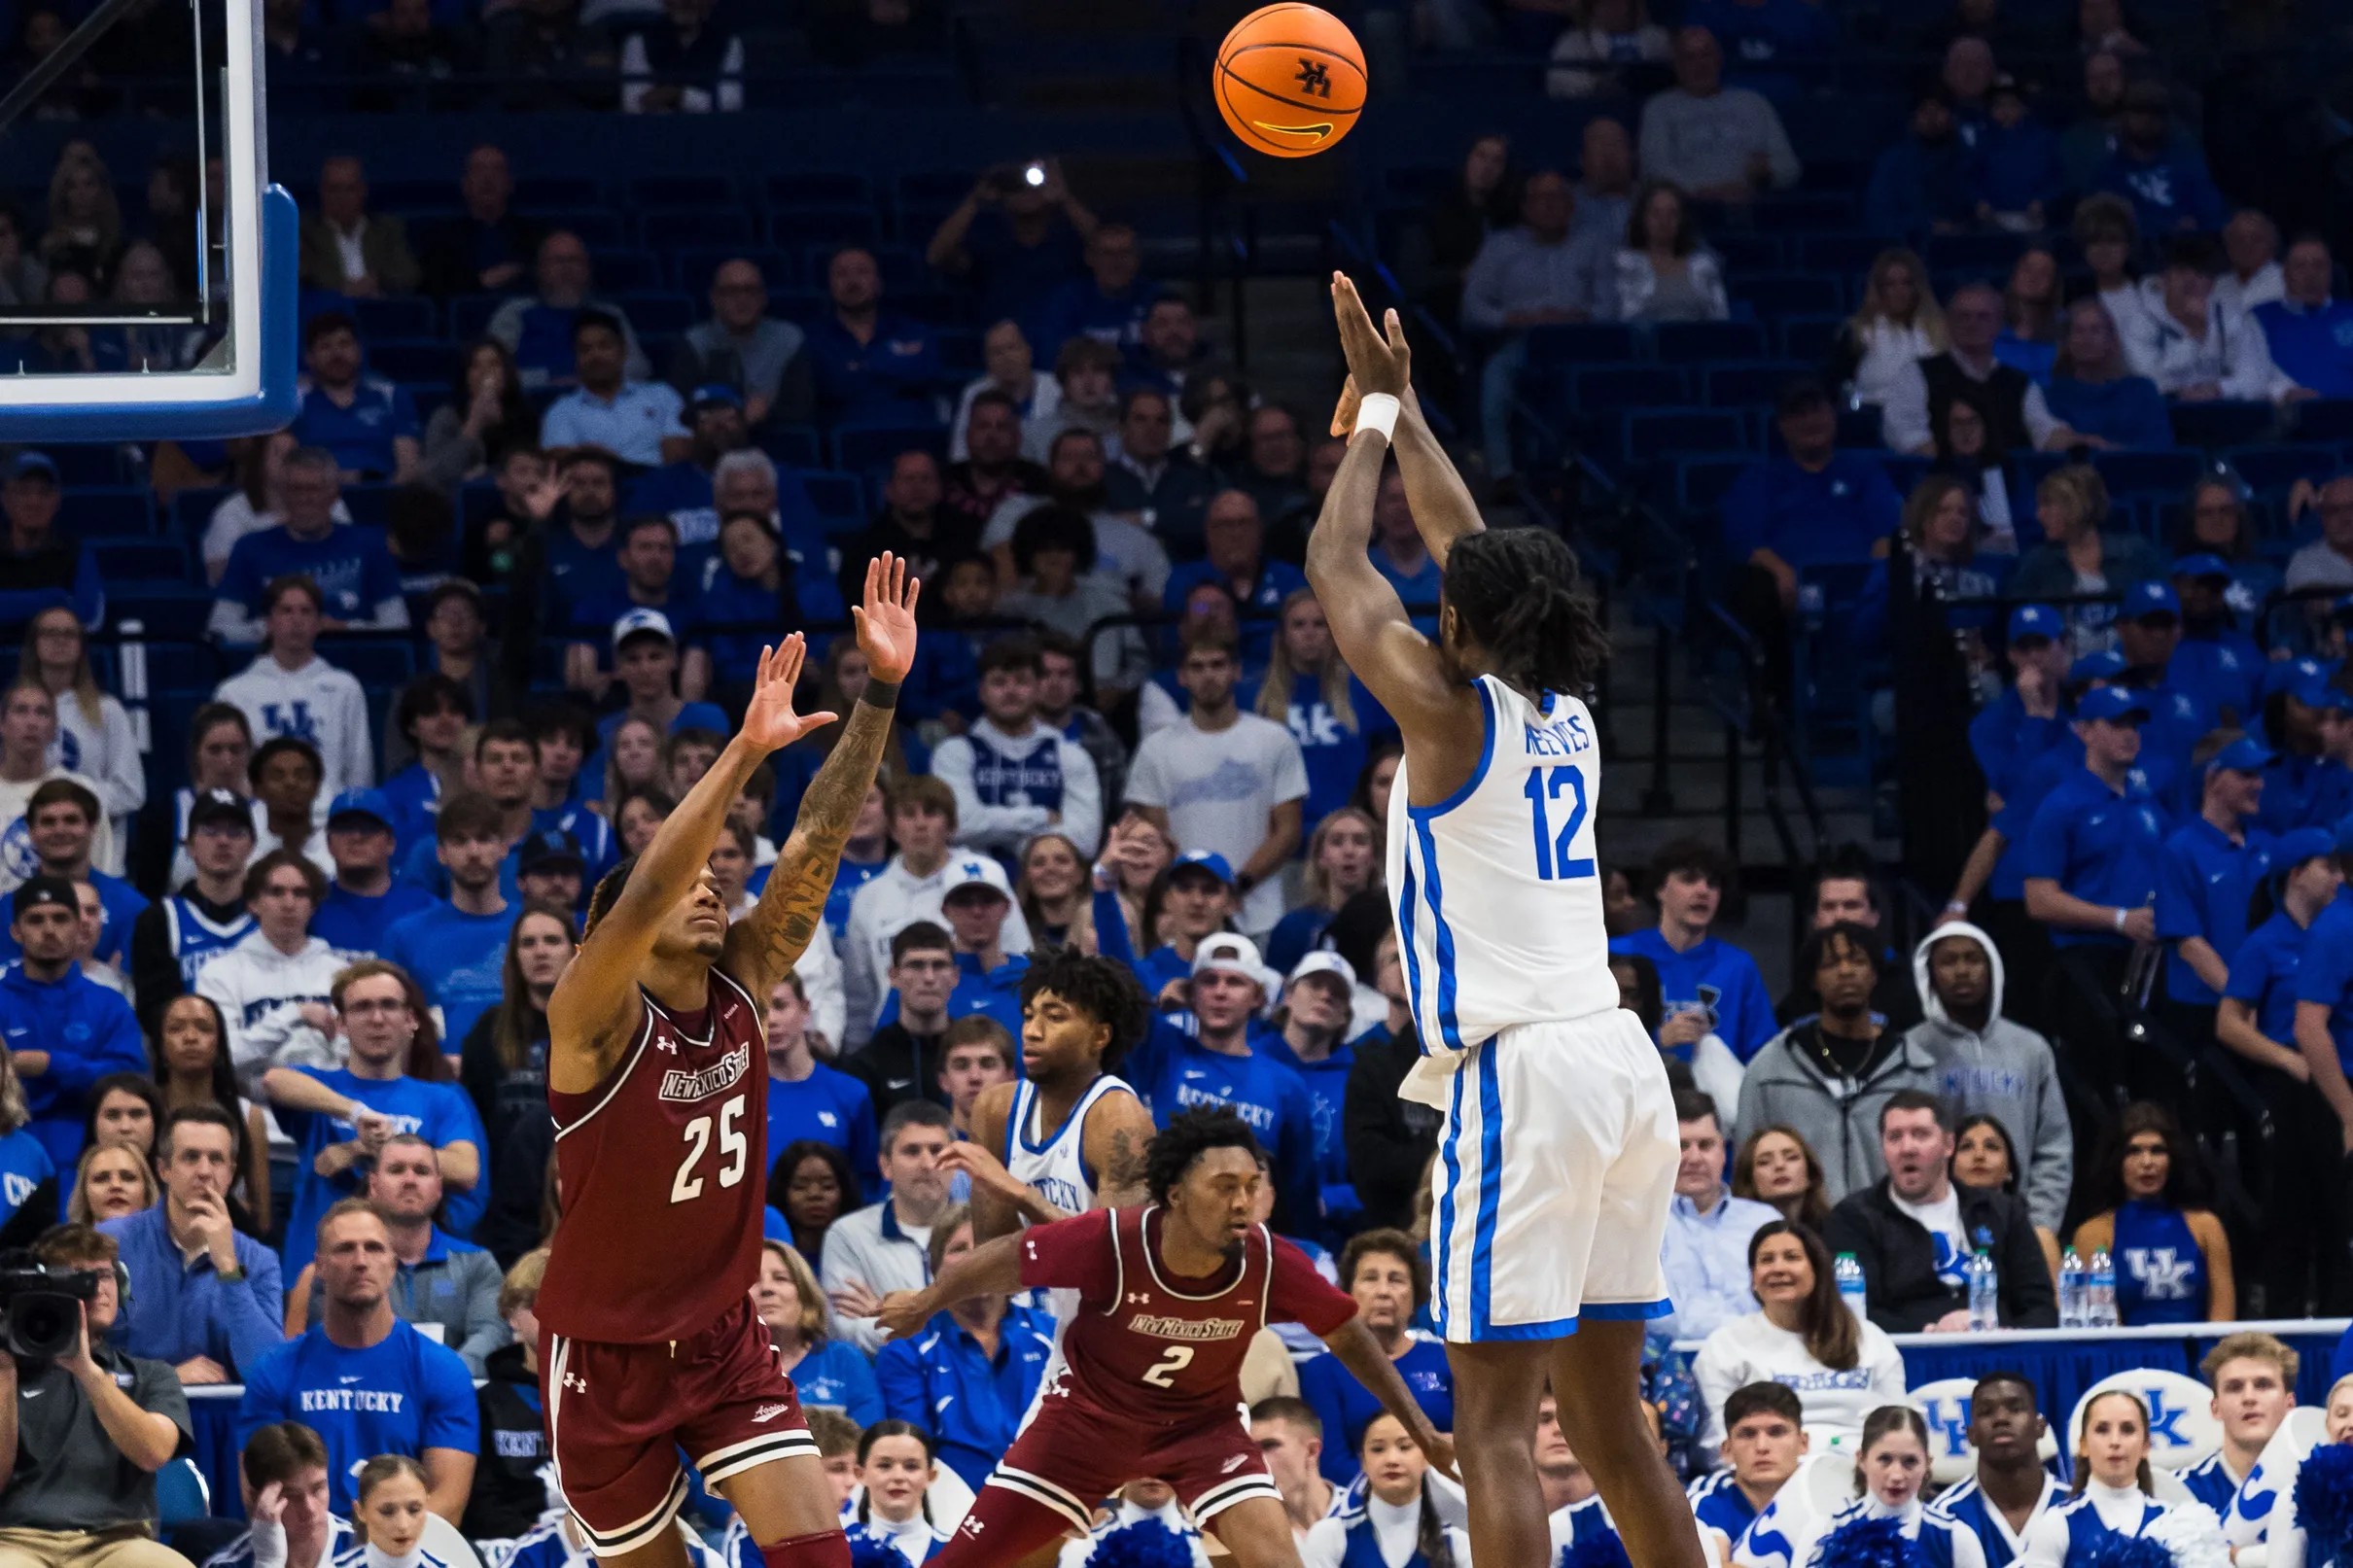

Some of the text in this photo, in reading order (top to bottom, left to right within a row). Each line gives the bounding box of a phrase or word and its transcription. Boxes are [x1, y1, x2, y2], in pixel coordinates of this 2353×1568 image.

[1525, 764, 1596, 881] 12
[664, 1073, 696, 1098] NEW
[671, 1094, 747, 1203] 25
[2124, 1246, 2195, 1300] UK
[1135, 1316, 1240, 1339] NEW MEXICO STATE
[1142, 1345, 1195, 1388] 2
[300, 1388, 404, 1413] KENTUCKY
